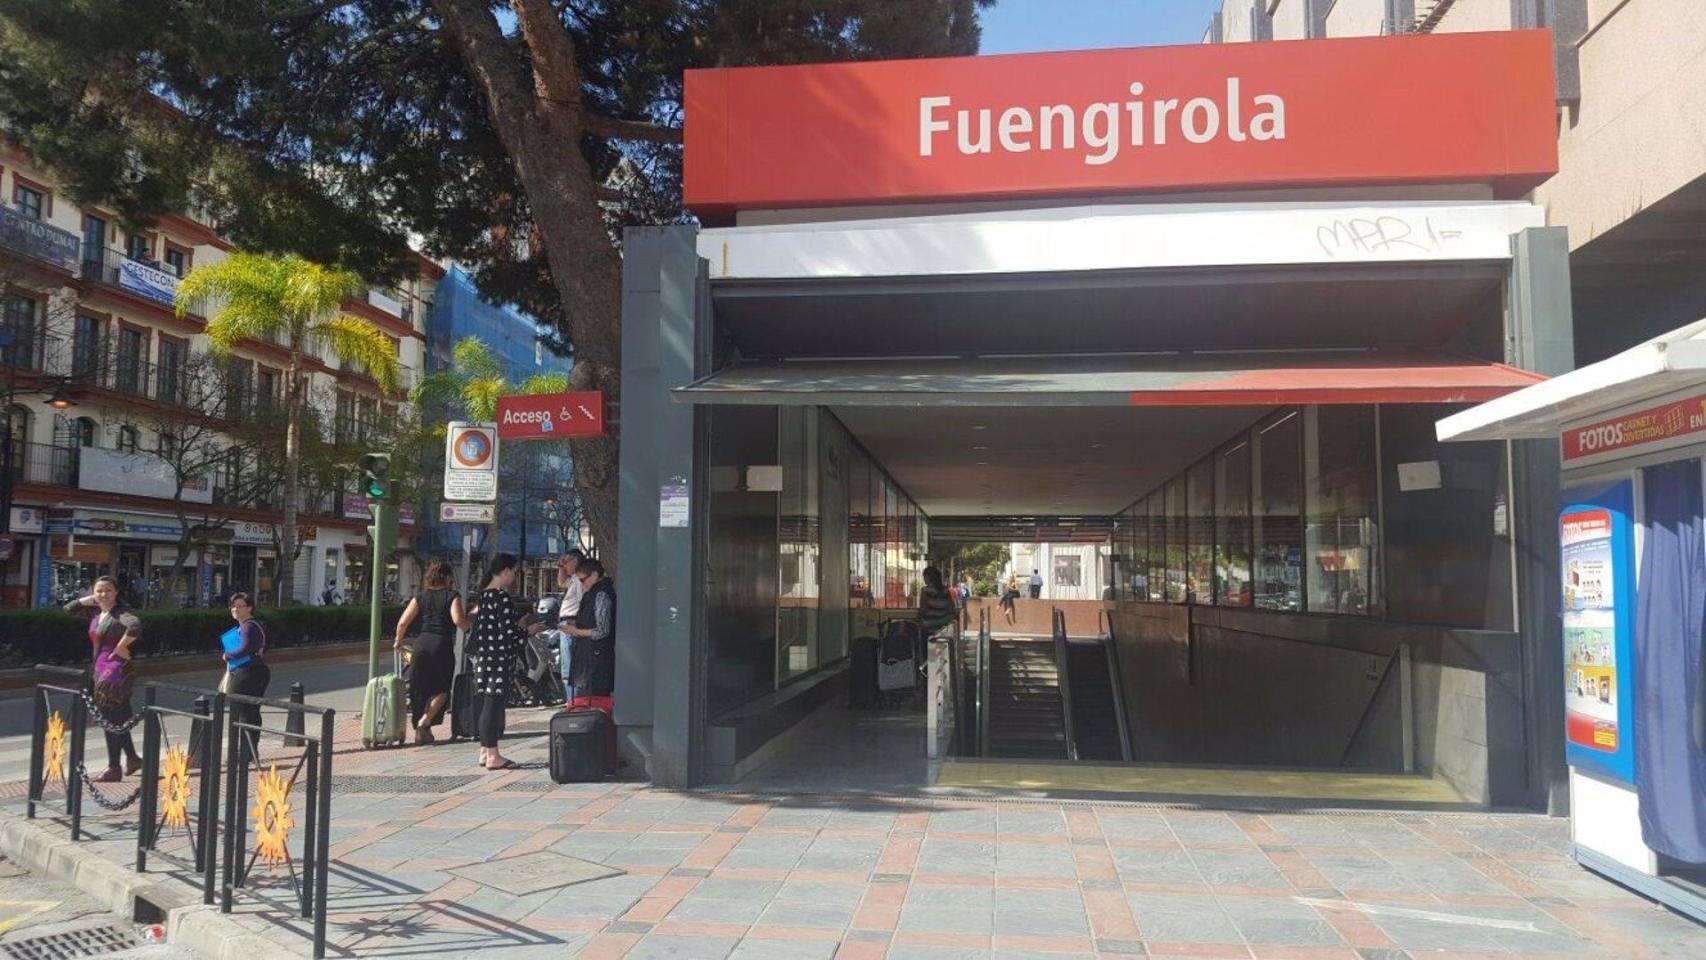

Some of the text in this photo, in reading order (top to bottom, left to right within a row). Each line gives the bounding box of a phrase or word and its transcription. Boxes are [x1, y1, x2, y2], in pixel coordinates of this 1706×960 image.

[919, 77, 1286, 165] Fuengirola
[503, 409, 551, 424] Acceso
[1579, 423, 1624, 452] FOTOS
[1690, 413, 1703, 428] EN
